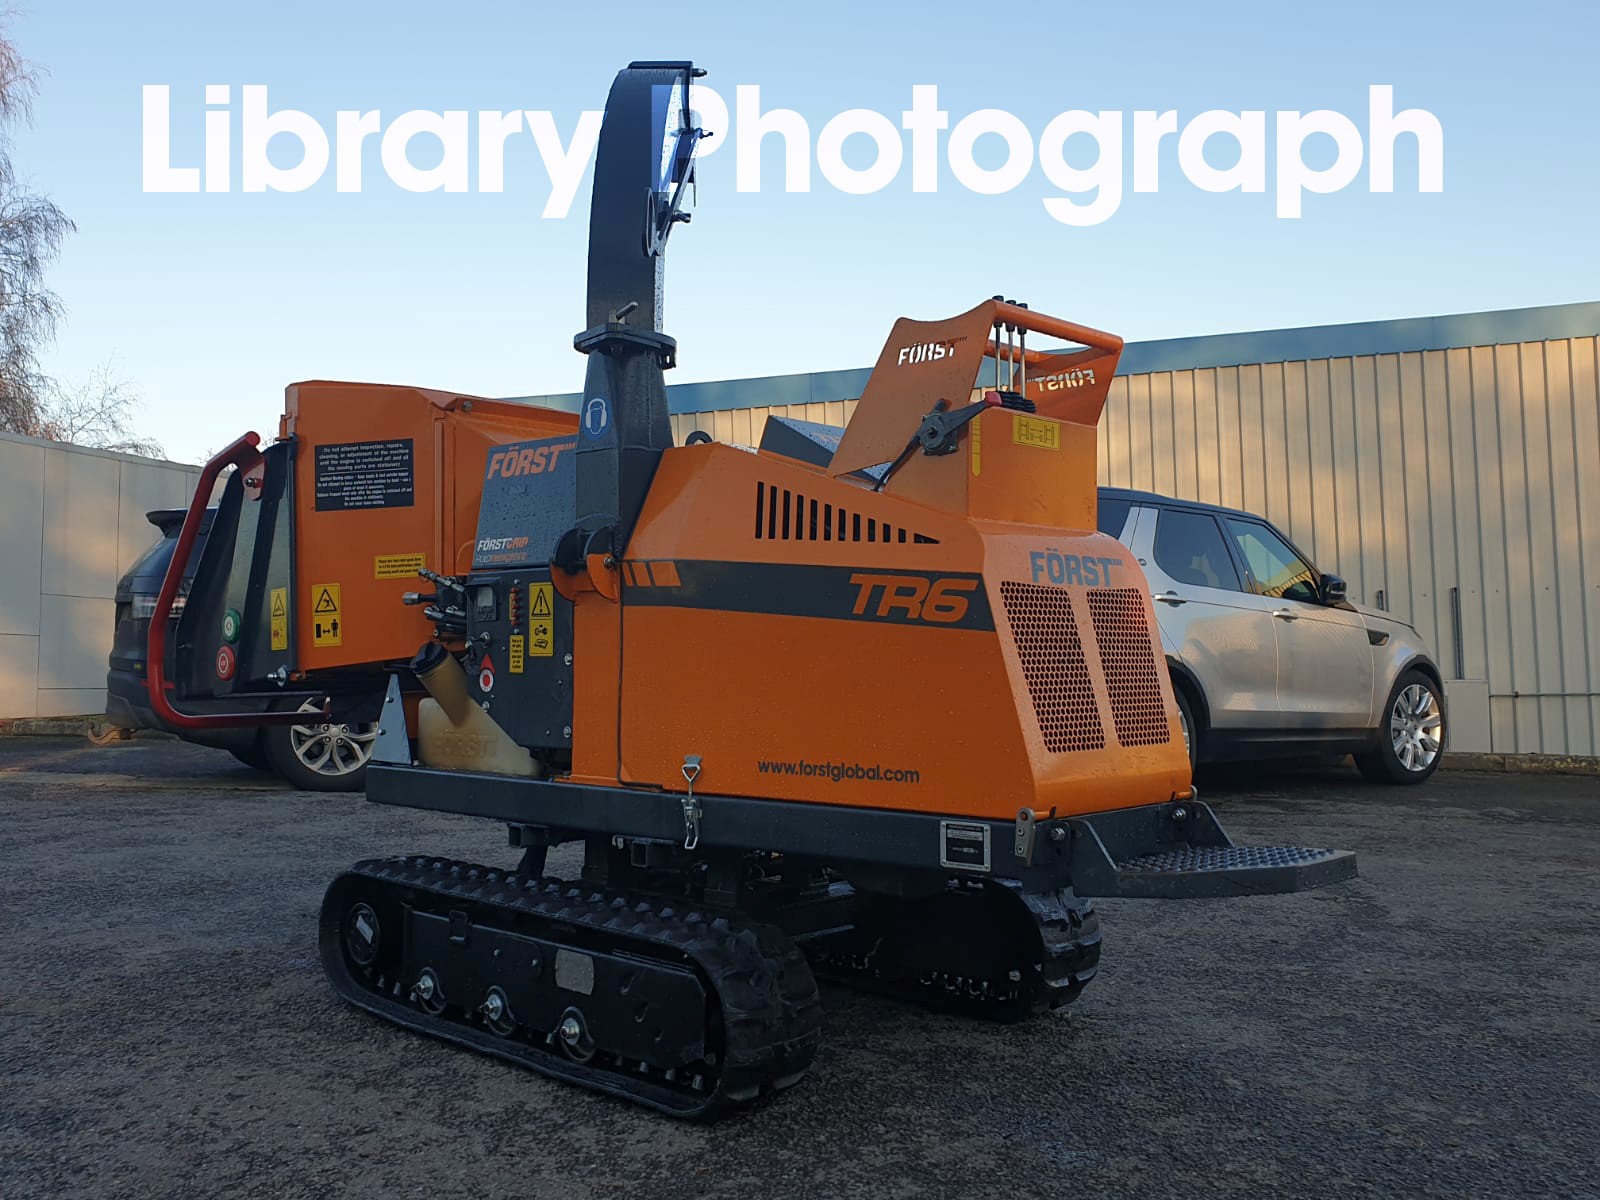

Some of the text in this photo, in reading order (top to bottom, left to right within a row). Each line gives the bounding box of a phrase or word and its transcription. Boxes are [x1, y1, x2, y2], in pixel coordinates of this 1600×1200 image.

[487, 443, 575, 480] FÖRST
[1030, 547, 1123, 587] FÖRST
[849, 573, 979, 623] TR6
[757, 759, 920, 785] www.forstglobal.com
